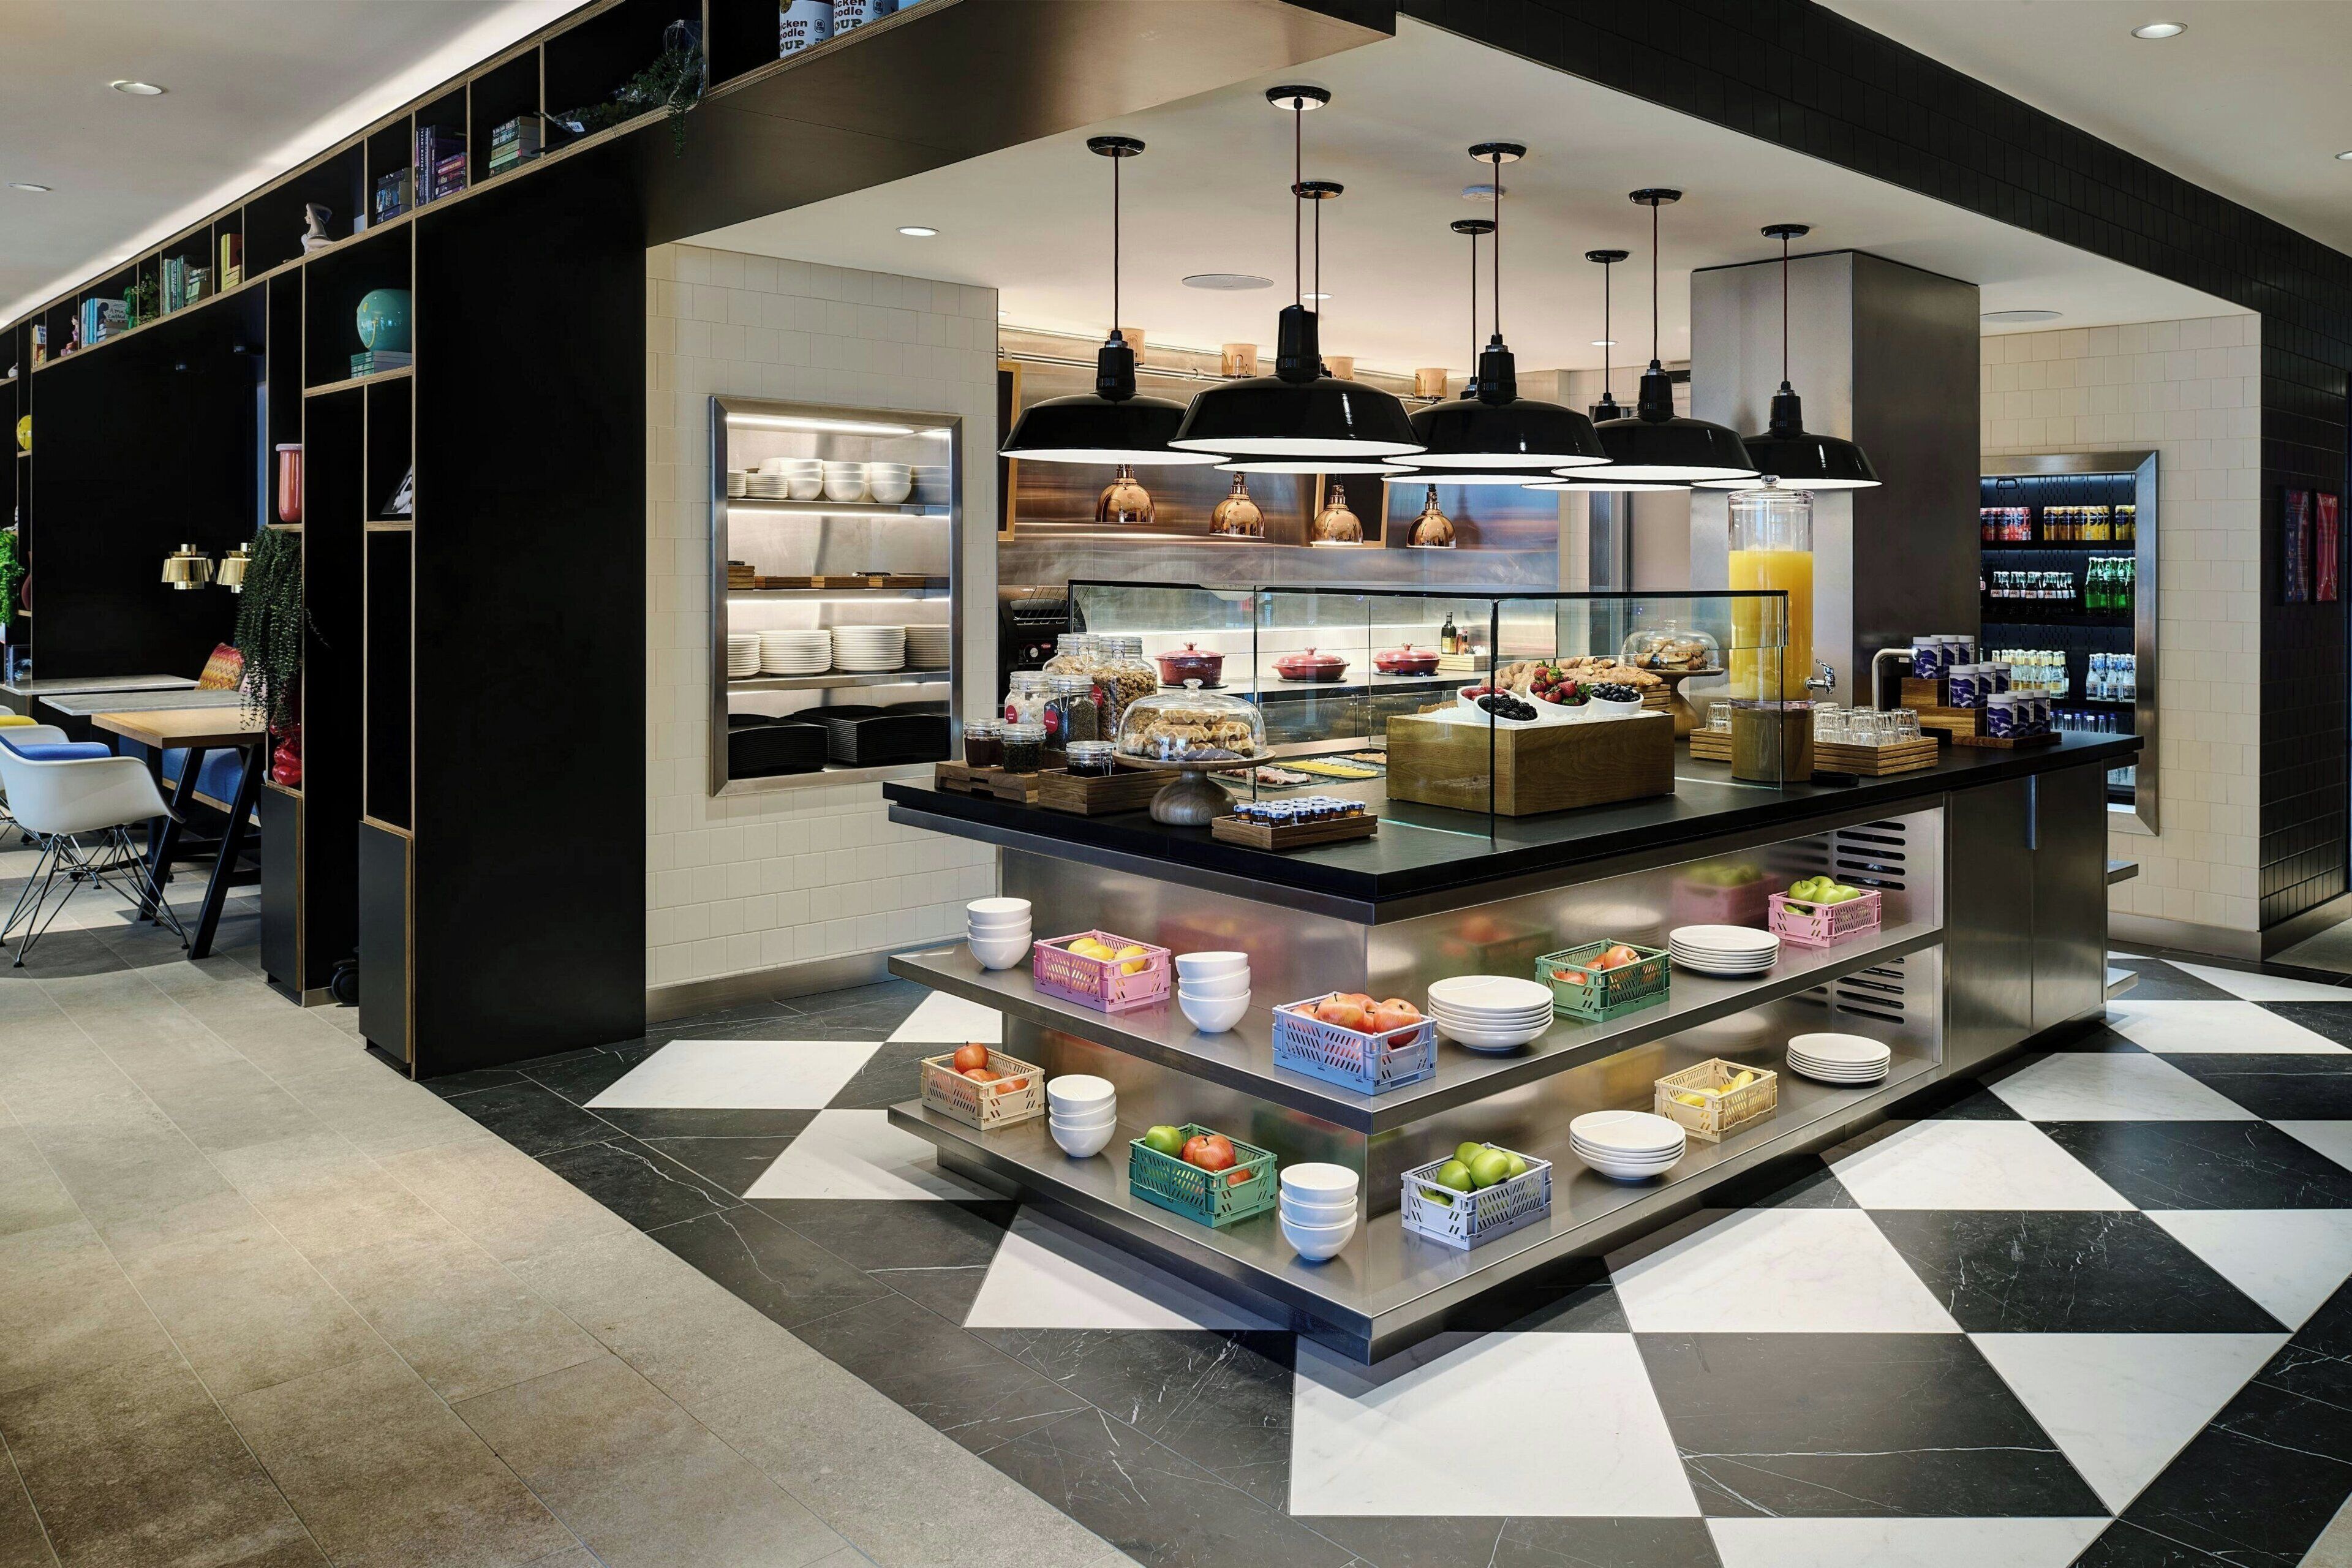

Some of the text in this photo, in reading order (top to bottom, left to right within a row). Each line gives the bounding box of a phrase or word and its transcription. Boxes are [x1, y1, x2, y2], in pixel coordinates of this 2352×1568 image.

[834, 7, 863, 18] oodle
[780, 20, 808, 31] icken
[835, 19, 862, 31] OUP
[780, 28, 805, 40] oodle
[780, 39, 805, 53] OUP
